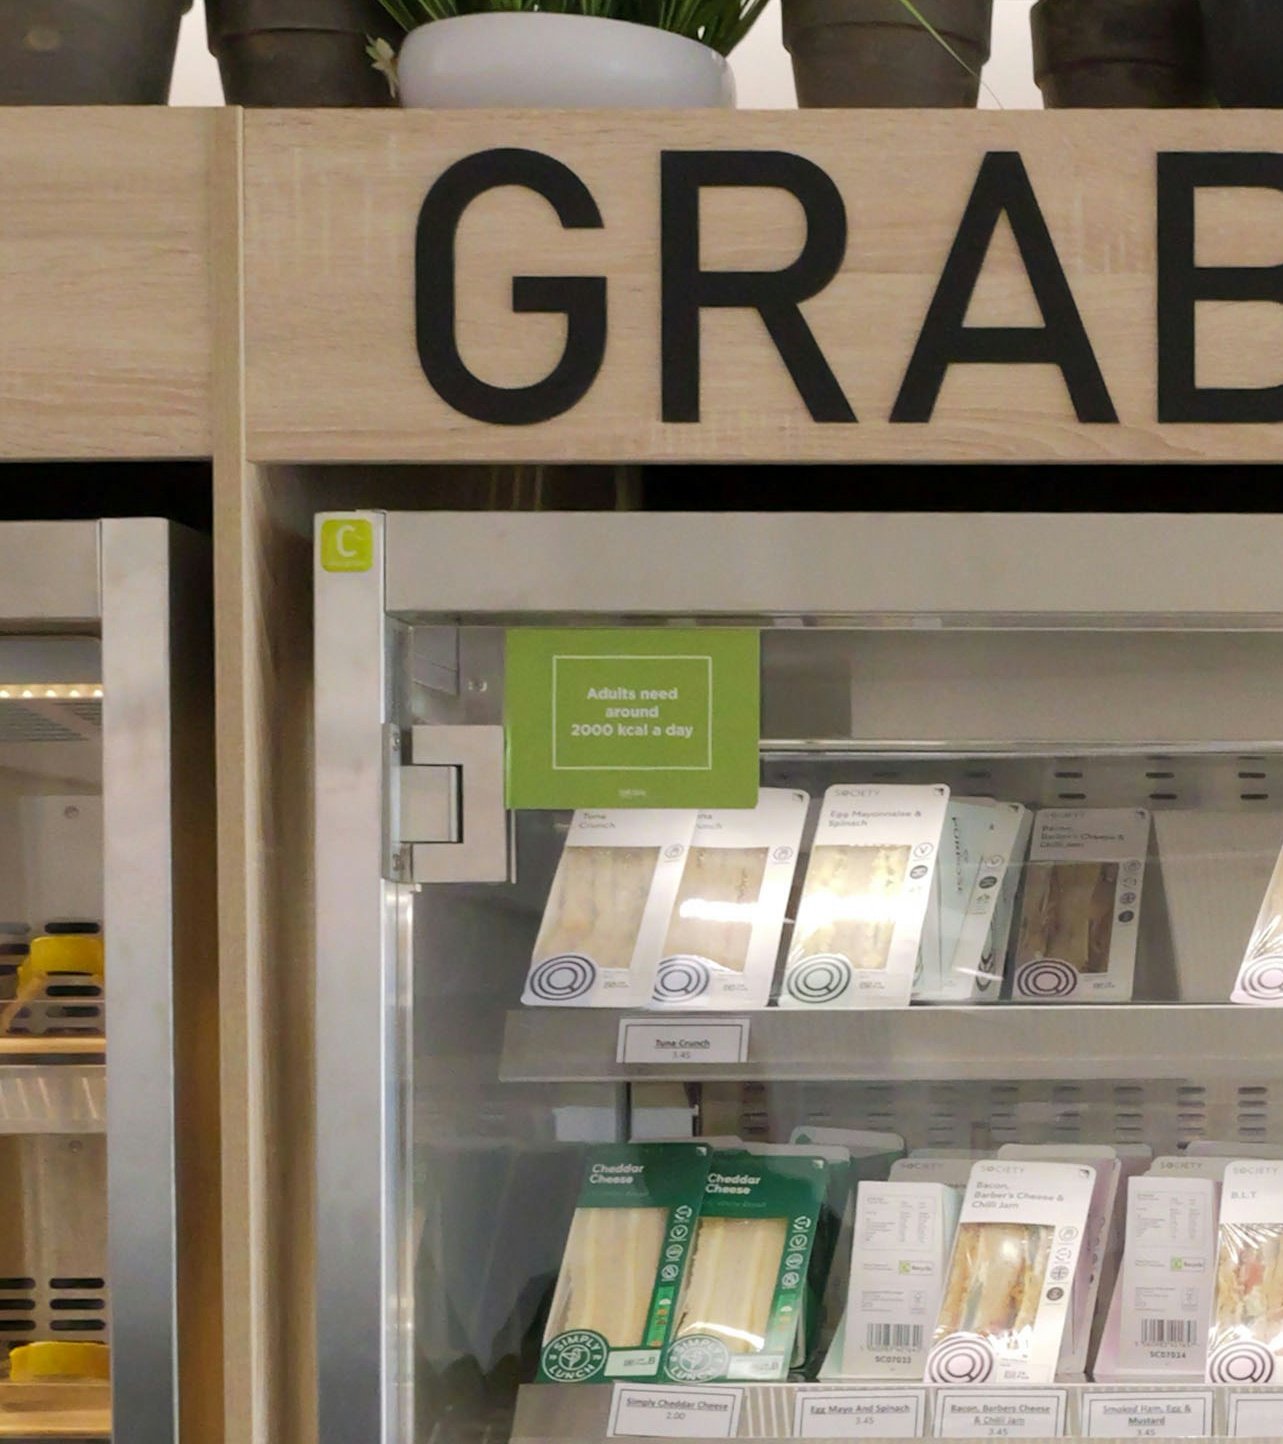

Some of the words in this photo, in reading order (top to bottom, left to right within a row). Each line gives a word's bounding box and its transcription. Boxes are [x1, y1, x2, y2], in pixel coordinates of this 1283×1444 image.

[336, 524, 358, 558] C
[587, 687, 636, 700] Adults
[640, 687, 678, 700] need
[606, 706, 659, 718] around
[571, 723, 614, 737] 2000
[617, 723, 649, 737] kcal
[651, 726, 662, 737] a
[665, 724, 694, 739] day
[590, 1163, 644, 1177] Cheddar
[589, 1173, 634, 1184] Cheese
